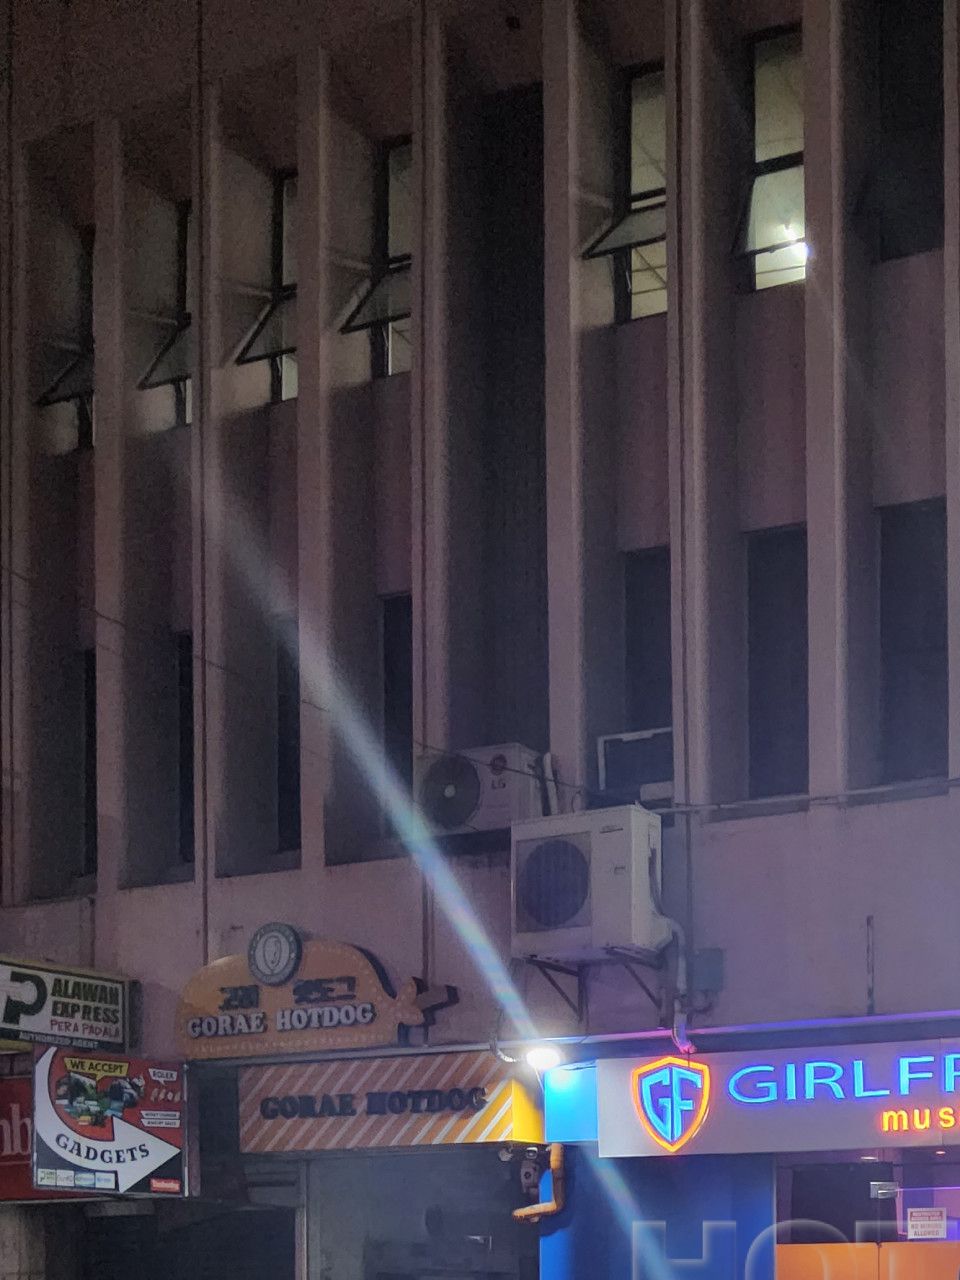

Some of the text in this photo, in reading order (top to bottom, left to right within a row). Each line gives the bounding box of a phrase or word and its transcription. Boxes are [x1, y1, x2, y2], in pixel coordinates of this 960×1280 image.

[51, 1000, 120, 1025] EXPRESS
[187, 1002, 375, 1039] GORAE HOTDOG
[69, 1059, 124, 1074] WE ACCEPT
[55, 1133, 150, 1164] GADGETS
